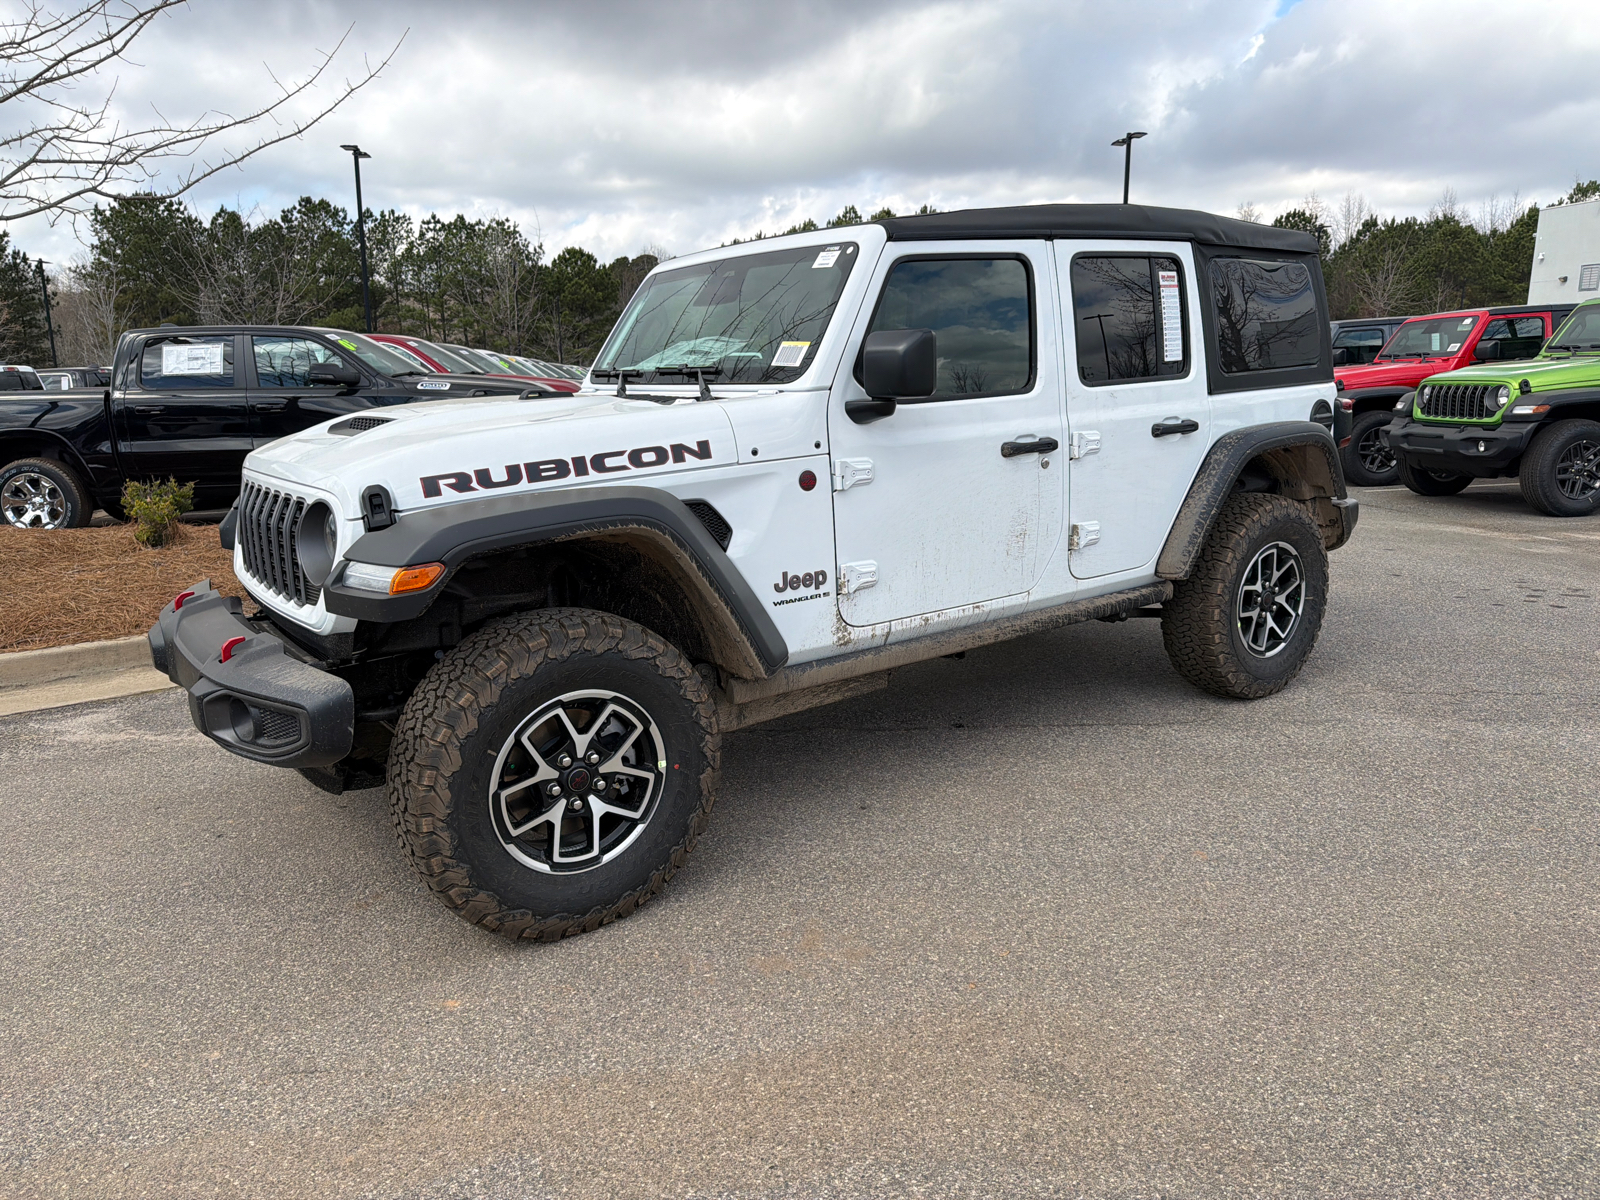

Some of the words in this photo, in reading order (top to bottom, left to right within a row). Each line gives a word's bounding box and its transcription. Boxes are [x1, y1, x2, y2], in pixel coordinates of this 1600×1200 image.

[419, 439, 713, 499] RUBICON
[773, 569, 828, 593] Jeep
[772, 593, 822, 607] WRANGLER
